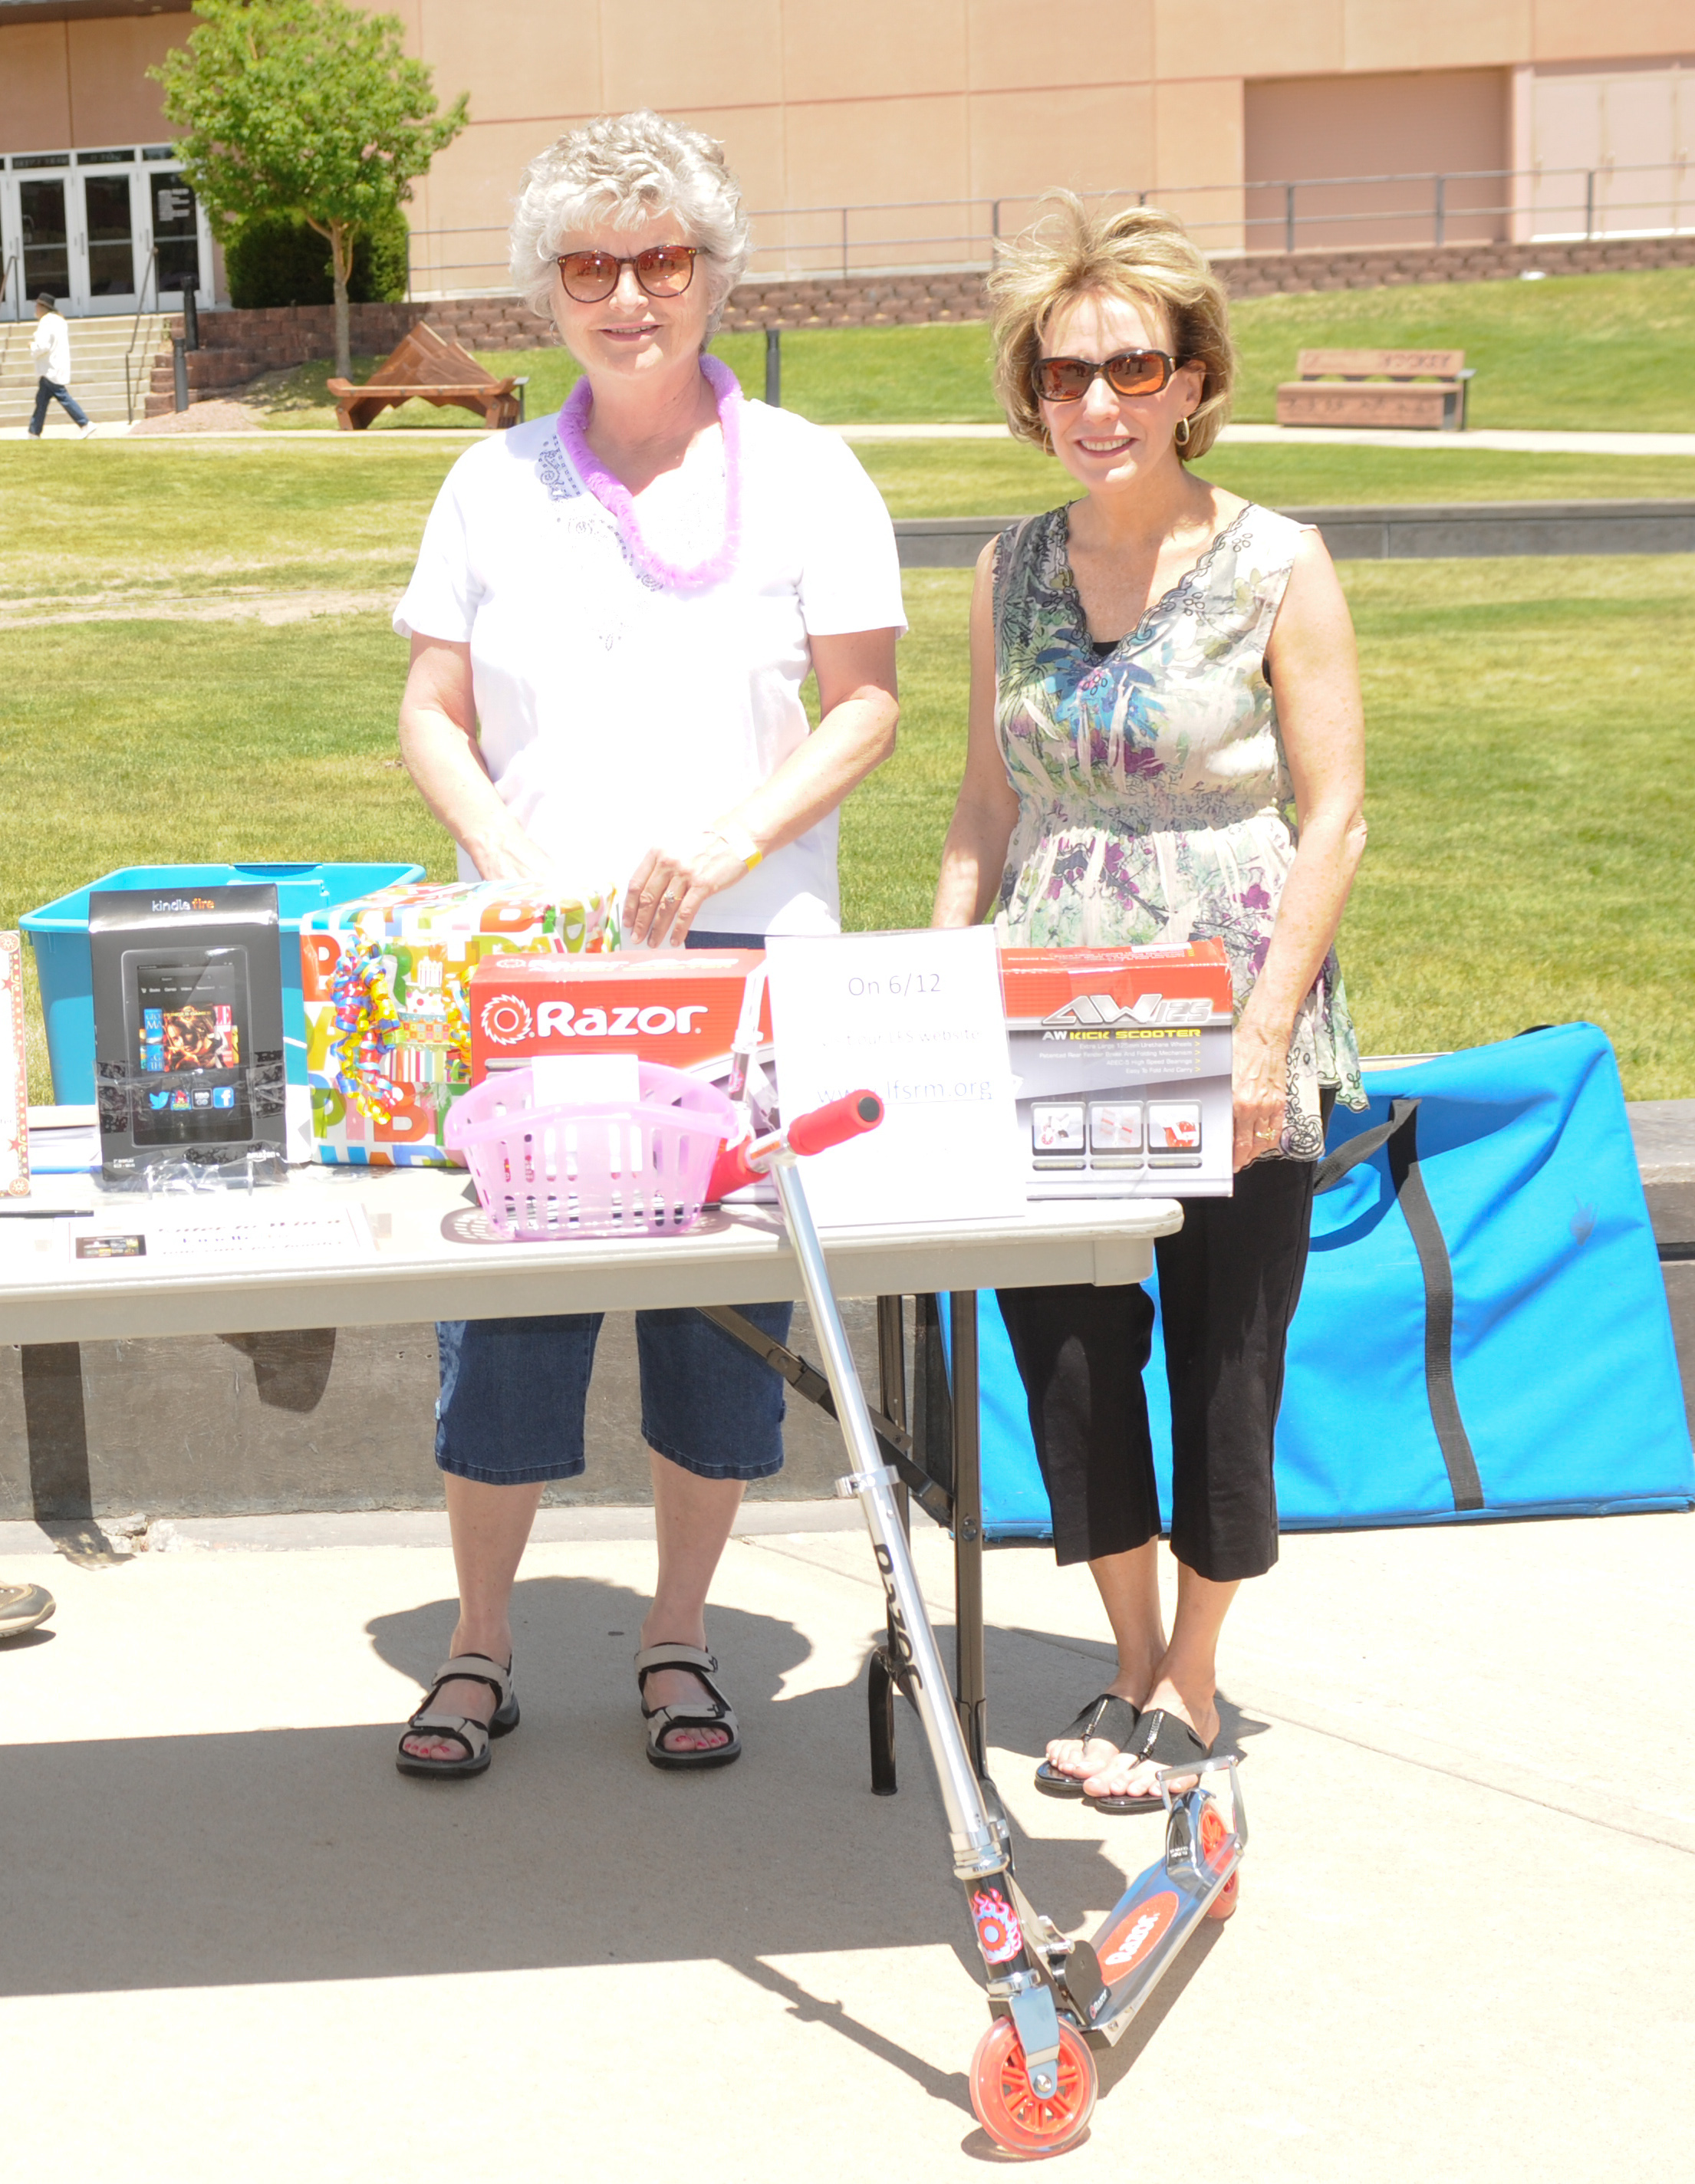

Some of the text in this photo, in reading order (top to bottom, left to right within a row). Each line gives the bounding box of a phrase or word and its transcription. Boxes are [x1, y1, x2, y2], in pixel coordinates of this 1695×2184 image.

[152, 898, 215, 912] kindle fire
[848, 973, 942, 996] On 6/12
[537, 1000, 709, 1038] Razor
[920, 1028, 983, 1043] website
[1042, 1029, 1201, 1041] AW KICK SCOOTER
[817, 1080, 994, 1104] wlfsrm.org
[1104, 1914, 1160, 1965] Razor
